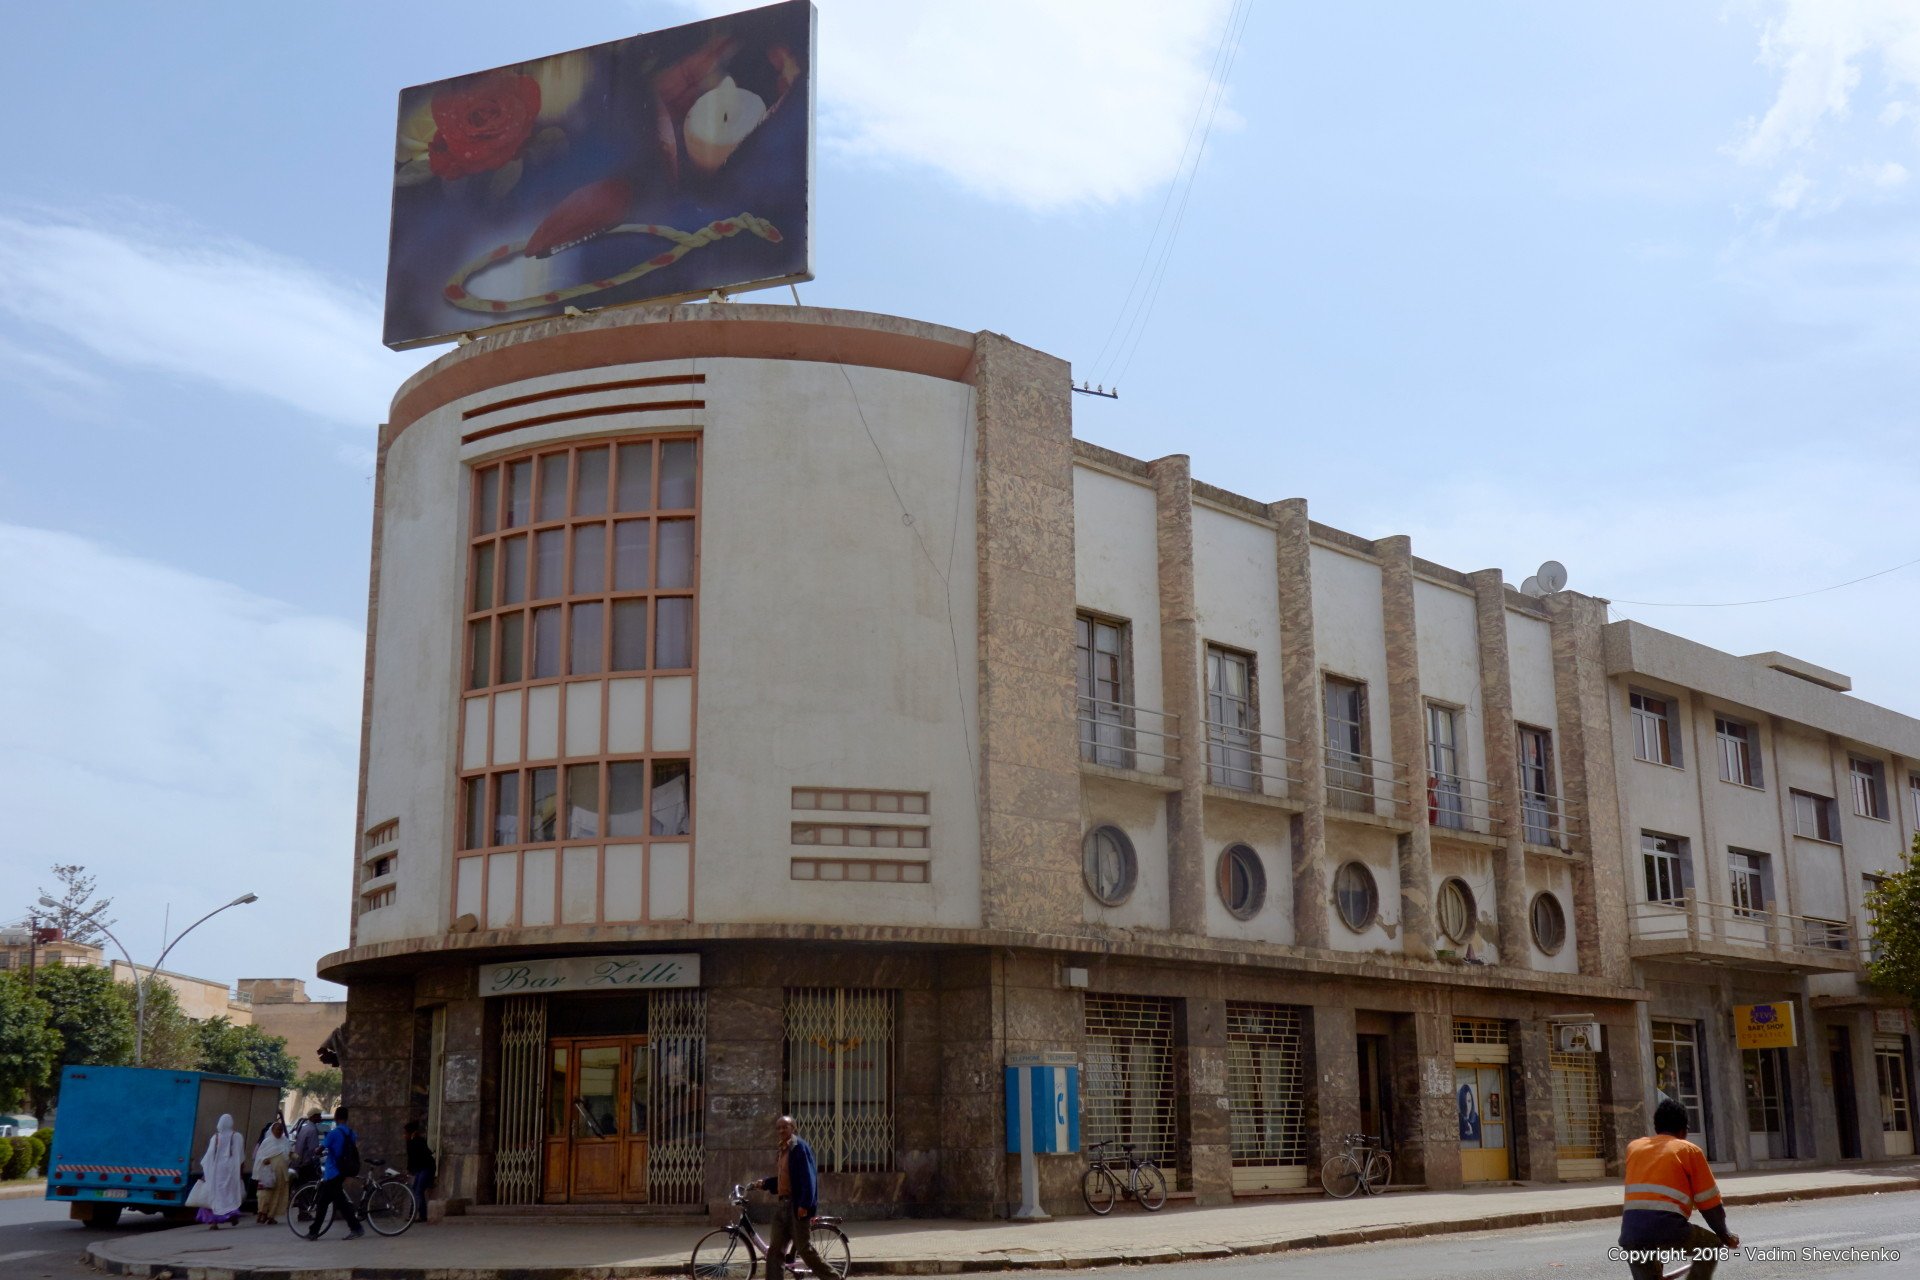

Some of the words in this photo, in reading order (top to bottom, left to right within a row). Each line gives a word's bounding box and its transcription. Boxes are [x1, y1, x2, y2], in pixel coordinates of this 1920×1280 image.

[492, 965, 567, 992] Bar
[585, 961, 682, 986] Zilli
[1010, 1055, 1040, 1063] TELEPHONE
[1047, 1054, 1074, 1062] TELEPHONE
